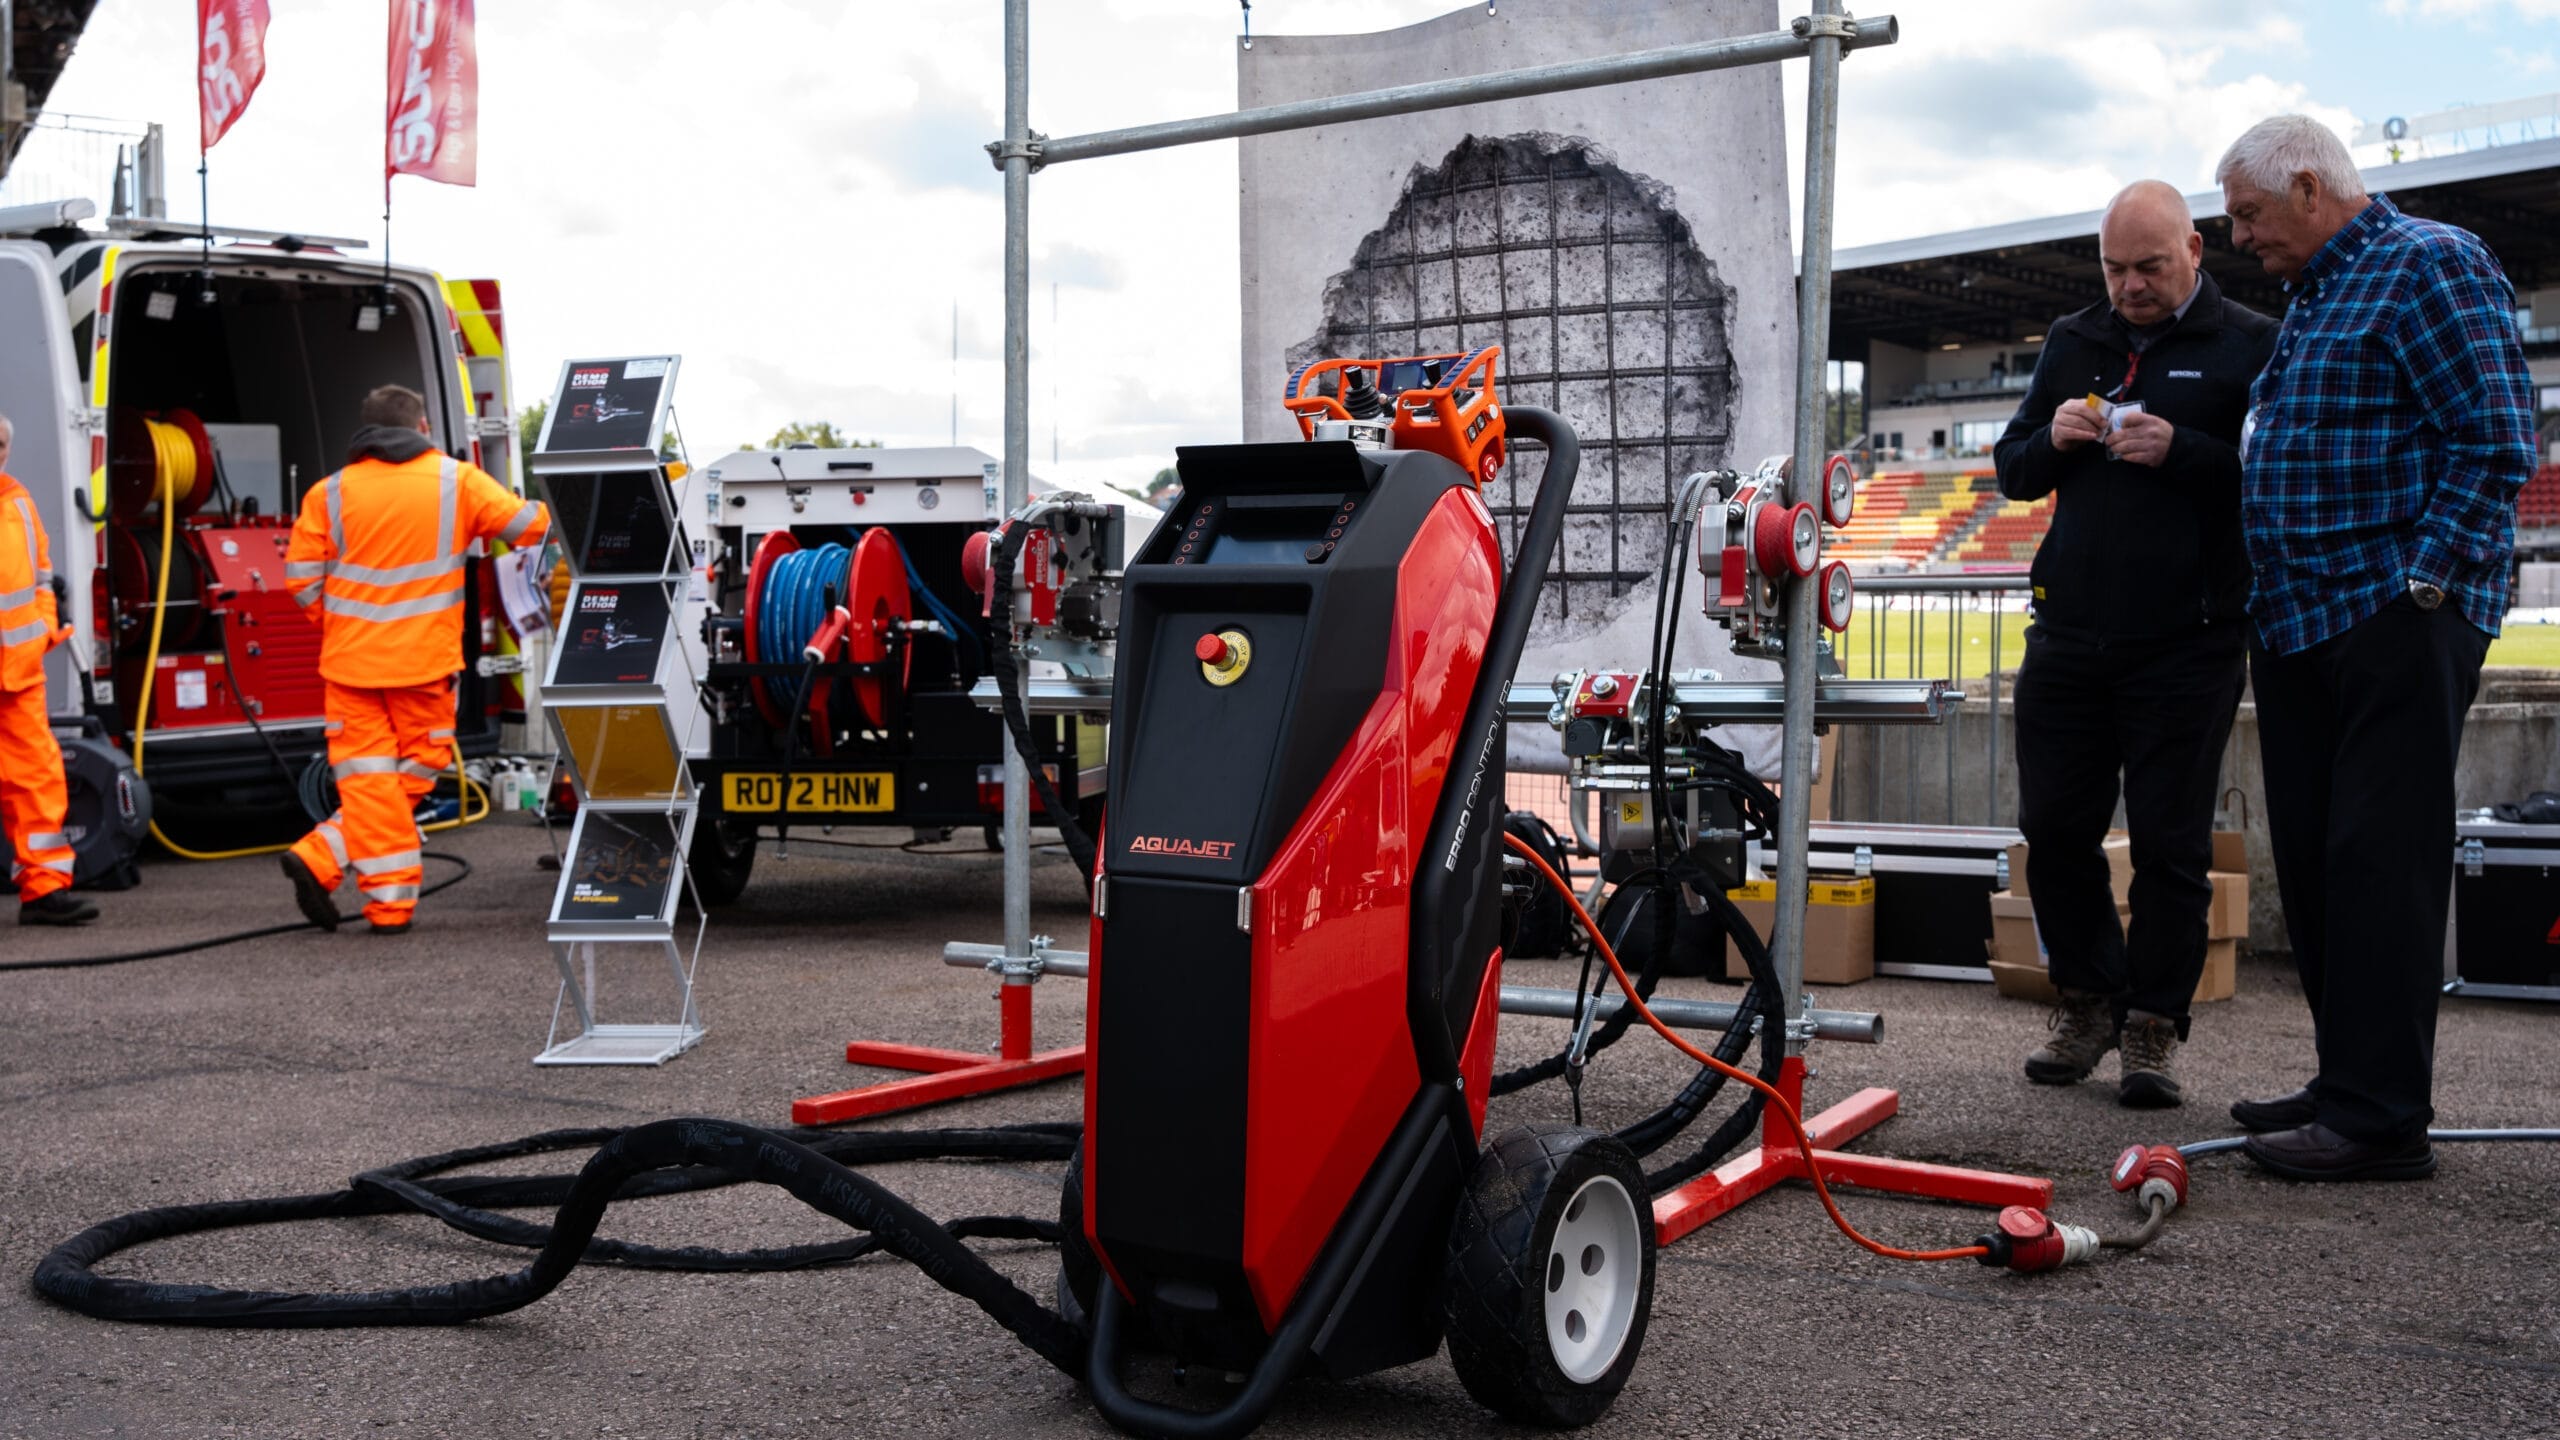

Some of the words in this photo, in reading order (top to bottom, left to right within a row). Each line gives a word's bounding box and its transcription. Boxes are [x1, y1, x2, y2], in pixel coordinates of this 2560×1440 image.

[583, 595, 618, 603] DEMO
[1445, 809, 1471, 872] ERGO
[1466, 679, 1512, 809] CONTROLLER
[823, 777, 880, 805] HNW
[1130, 836, 1236, 857] AQUAJET
[819, 1172, 872, 1217] MSHA
